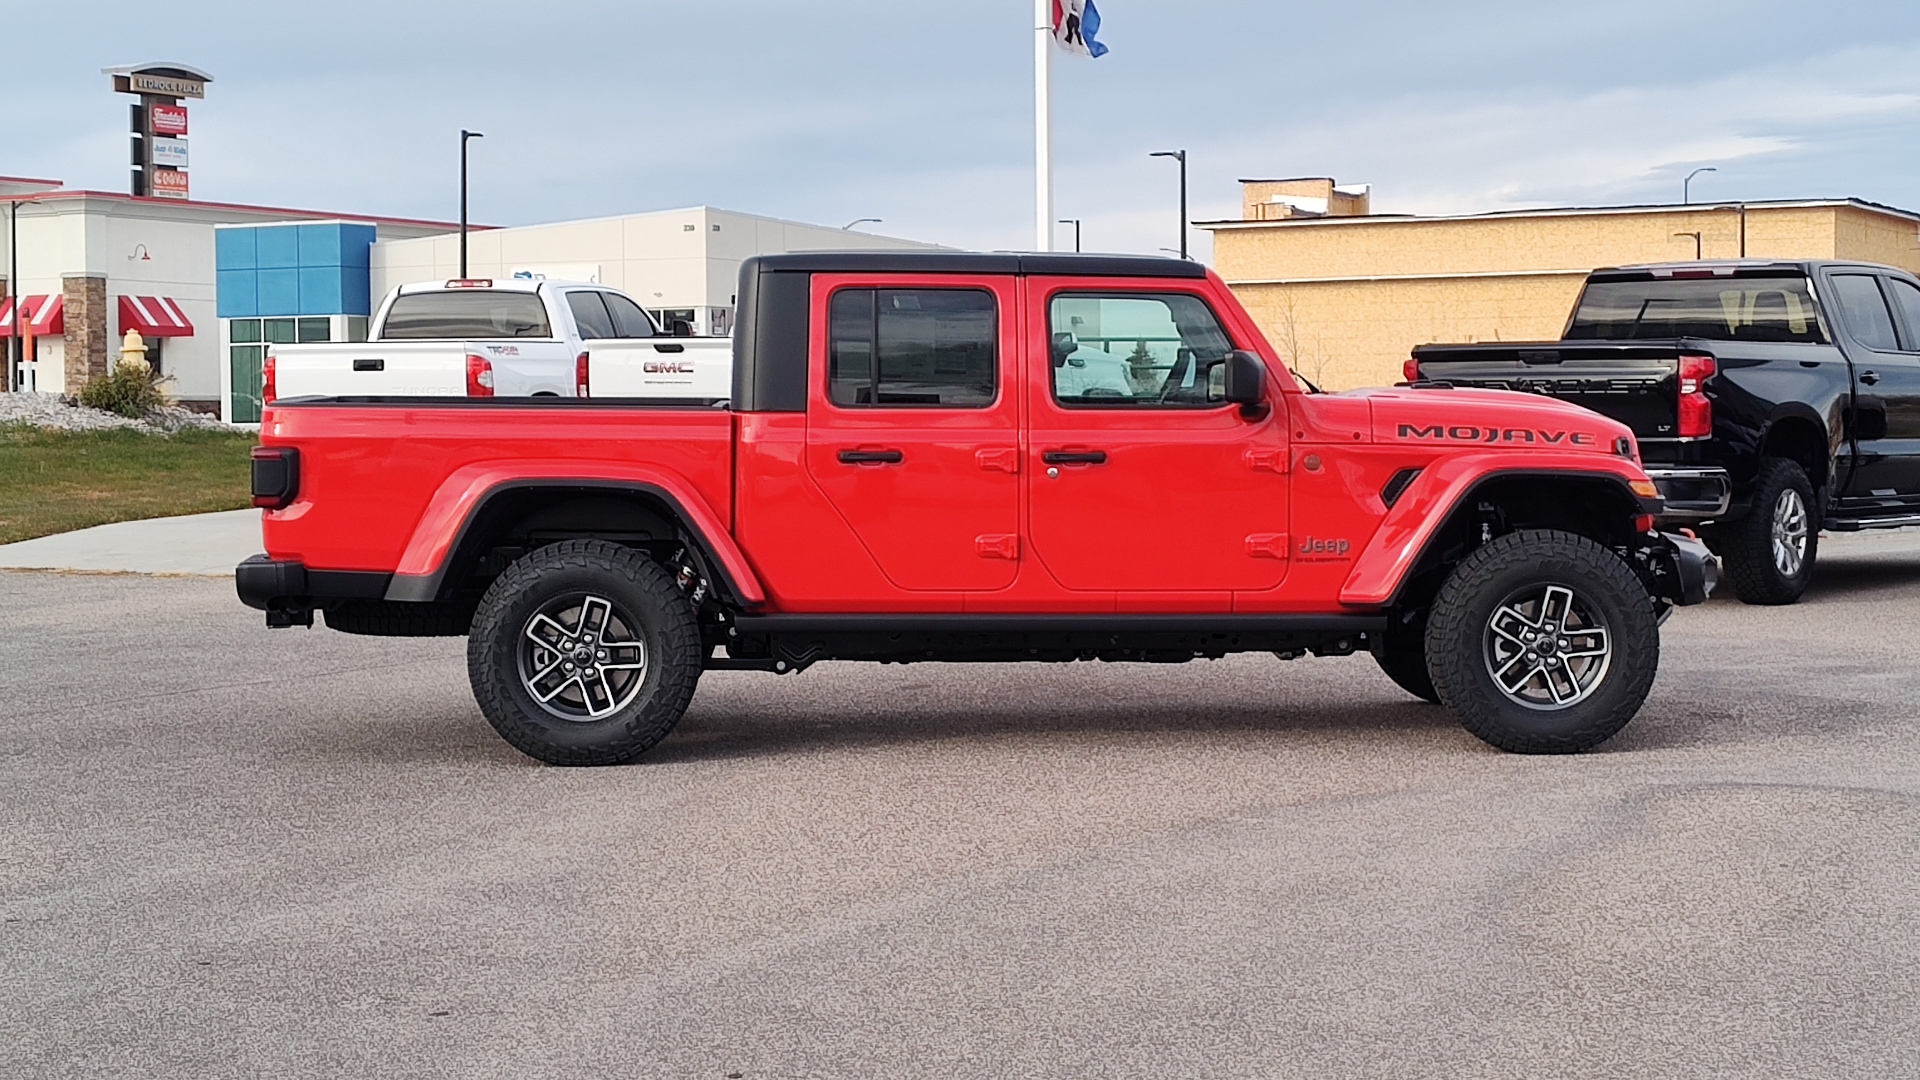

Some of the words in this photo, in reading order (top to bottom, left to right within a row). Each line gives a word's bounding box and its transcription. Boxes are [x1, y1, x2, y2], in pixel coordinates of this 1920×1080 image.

[177, 82, 203, 95] PLAZA
[643, 361, 695, 374] GMC
[1396, 423, 1597, 447] MOJAVE
[1299, 535, 1350, 556] Jeep
